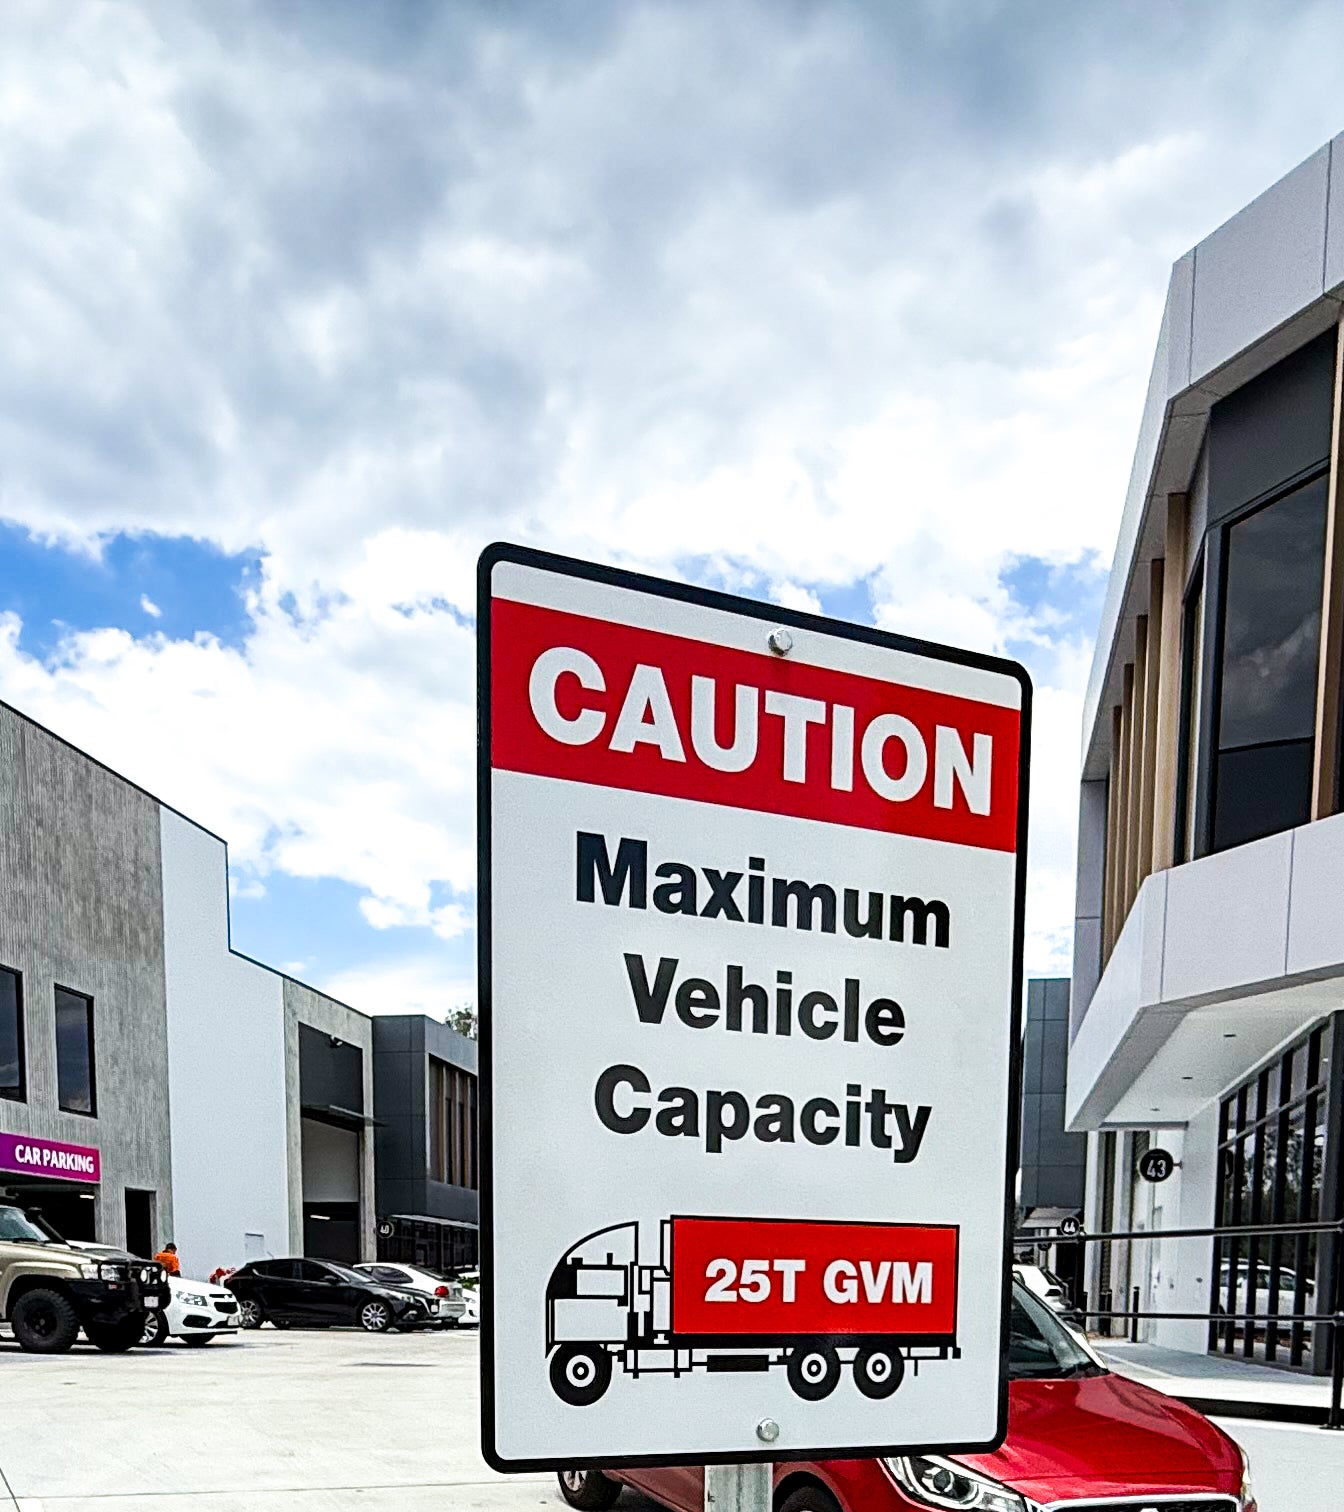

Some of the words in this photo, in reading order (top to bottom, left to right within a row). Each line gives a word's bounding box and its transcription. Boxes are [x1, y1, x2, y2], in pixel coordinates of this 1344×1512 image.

[528, 646, 994, 817] CAUTION
[576, 831, 951, 949] Maximum
[623, 952, 906, 1047] Vehicle
[15, 1144, 42, 1166] CAR
[43, 1148, 95, 1174] PARKING
[594, 1064, 932, 1164] Capacity
[1146, 1159, 1167, 1178] 43
[704, 1258, 806, 1303] 25T
[823, 1259, 933, 1304] GVM
